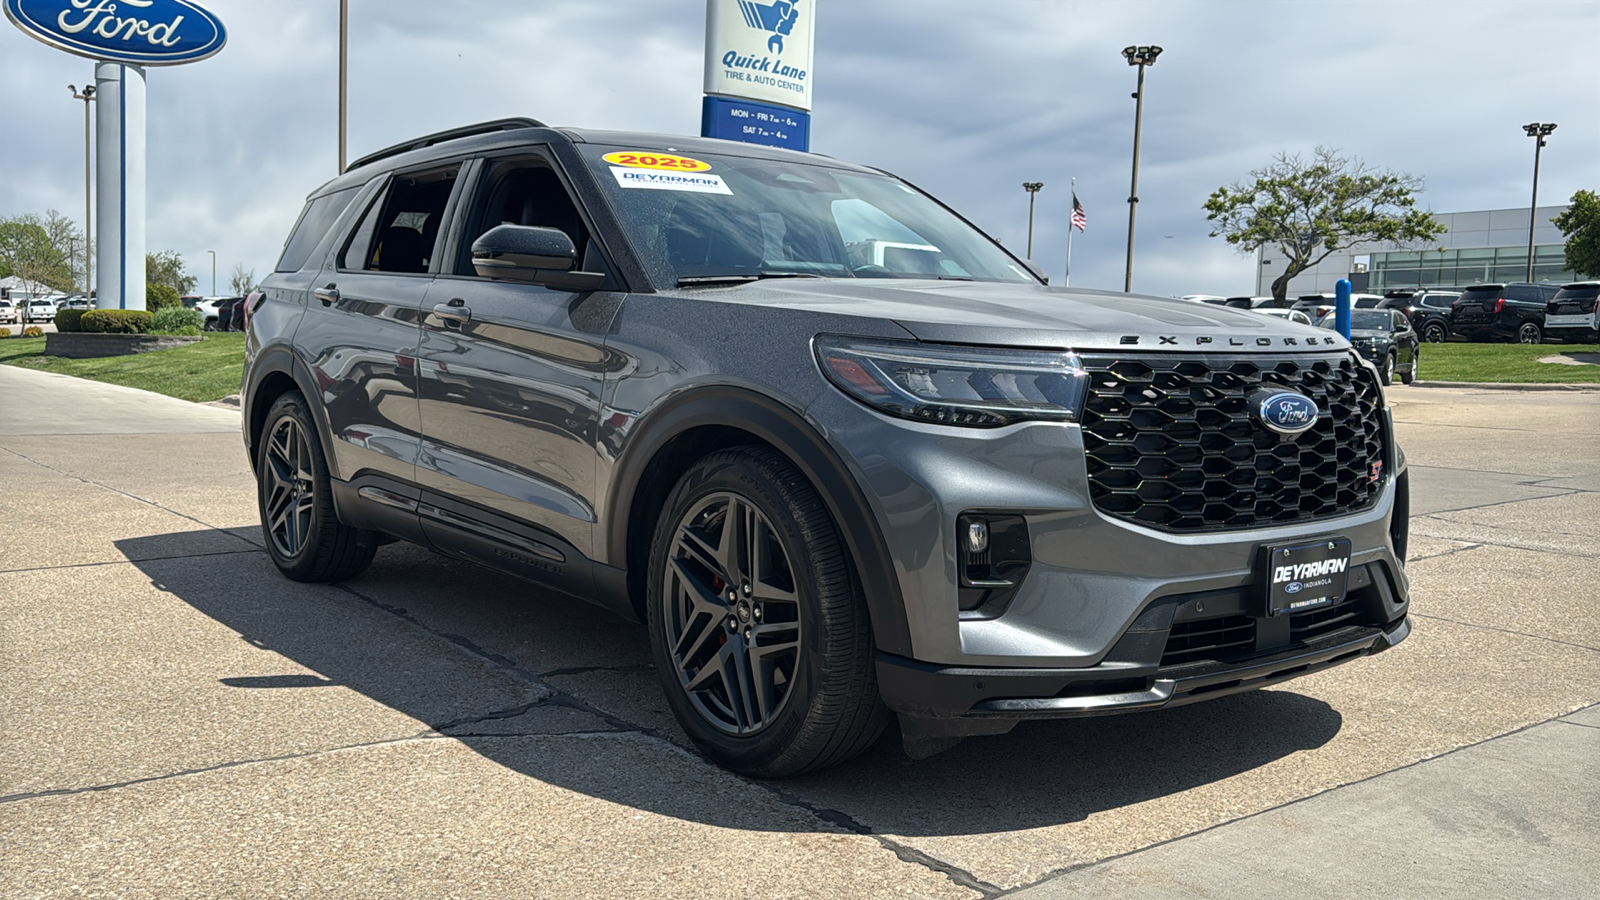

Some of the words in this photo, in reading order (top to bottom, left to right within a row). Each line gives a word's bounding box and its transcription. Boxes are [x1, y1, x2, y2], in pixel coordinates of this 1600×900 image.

[57, 0, 184, 47] Ford
[722, 50, 770, 72] Quick
[771, 59, 807, 81] Lane
[724, 70, 744, 81] TIRE
[745, 73, 752, 82] &
[754, 75, 776, 86] AUTO
[777, 80, 804, 94] CENTER
[731, 109, 749, 118] MON
[757, 112, 768, 121] FRI
[742, 125, 756, 134] SAT
[618, 154, 699, 169] 2025
[623, 172, 719, 186] DEYARMAN
[1120, 335, 1336, 347] EXPLORER
[1277, 401, 1309, 423] Ford
[1273, 557, 1348, 584] DEYARMAN
[1303, 578, 1332, 589] INDIANOLA
